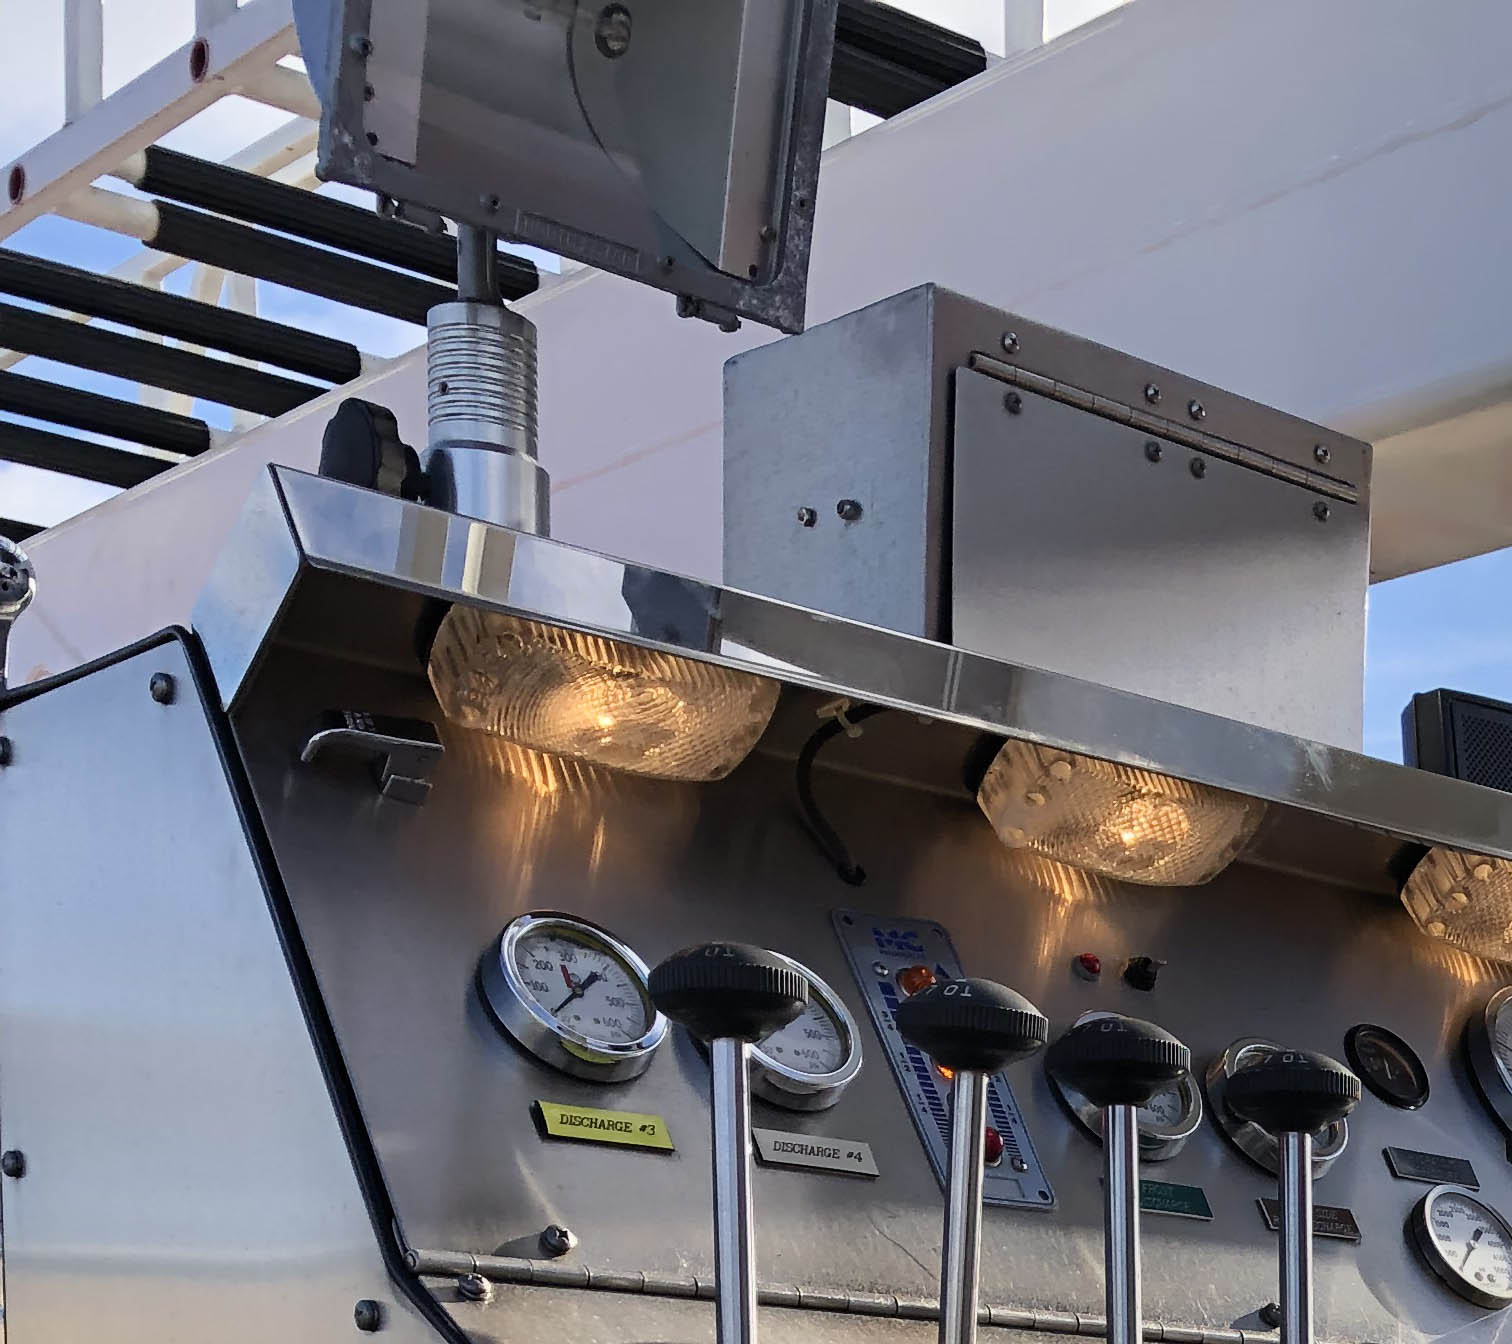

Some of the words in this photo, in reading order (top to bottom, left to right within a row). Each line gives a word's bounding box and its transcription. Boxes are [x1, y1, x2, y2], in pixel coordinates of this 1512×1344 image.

[533, 959, 554, 971] 200
[531, 980, 549, 992] 100
[560, 1113, 633, 1133] DISCHARGE
[639, 1124, 656, 1136] #3
[773, 1141, 840, 1159] DISCHARGE
[846, 1151, 863, 1163] #4
